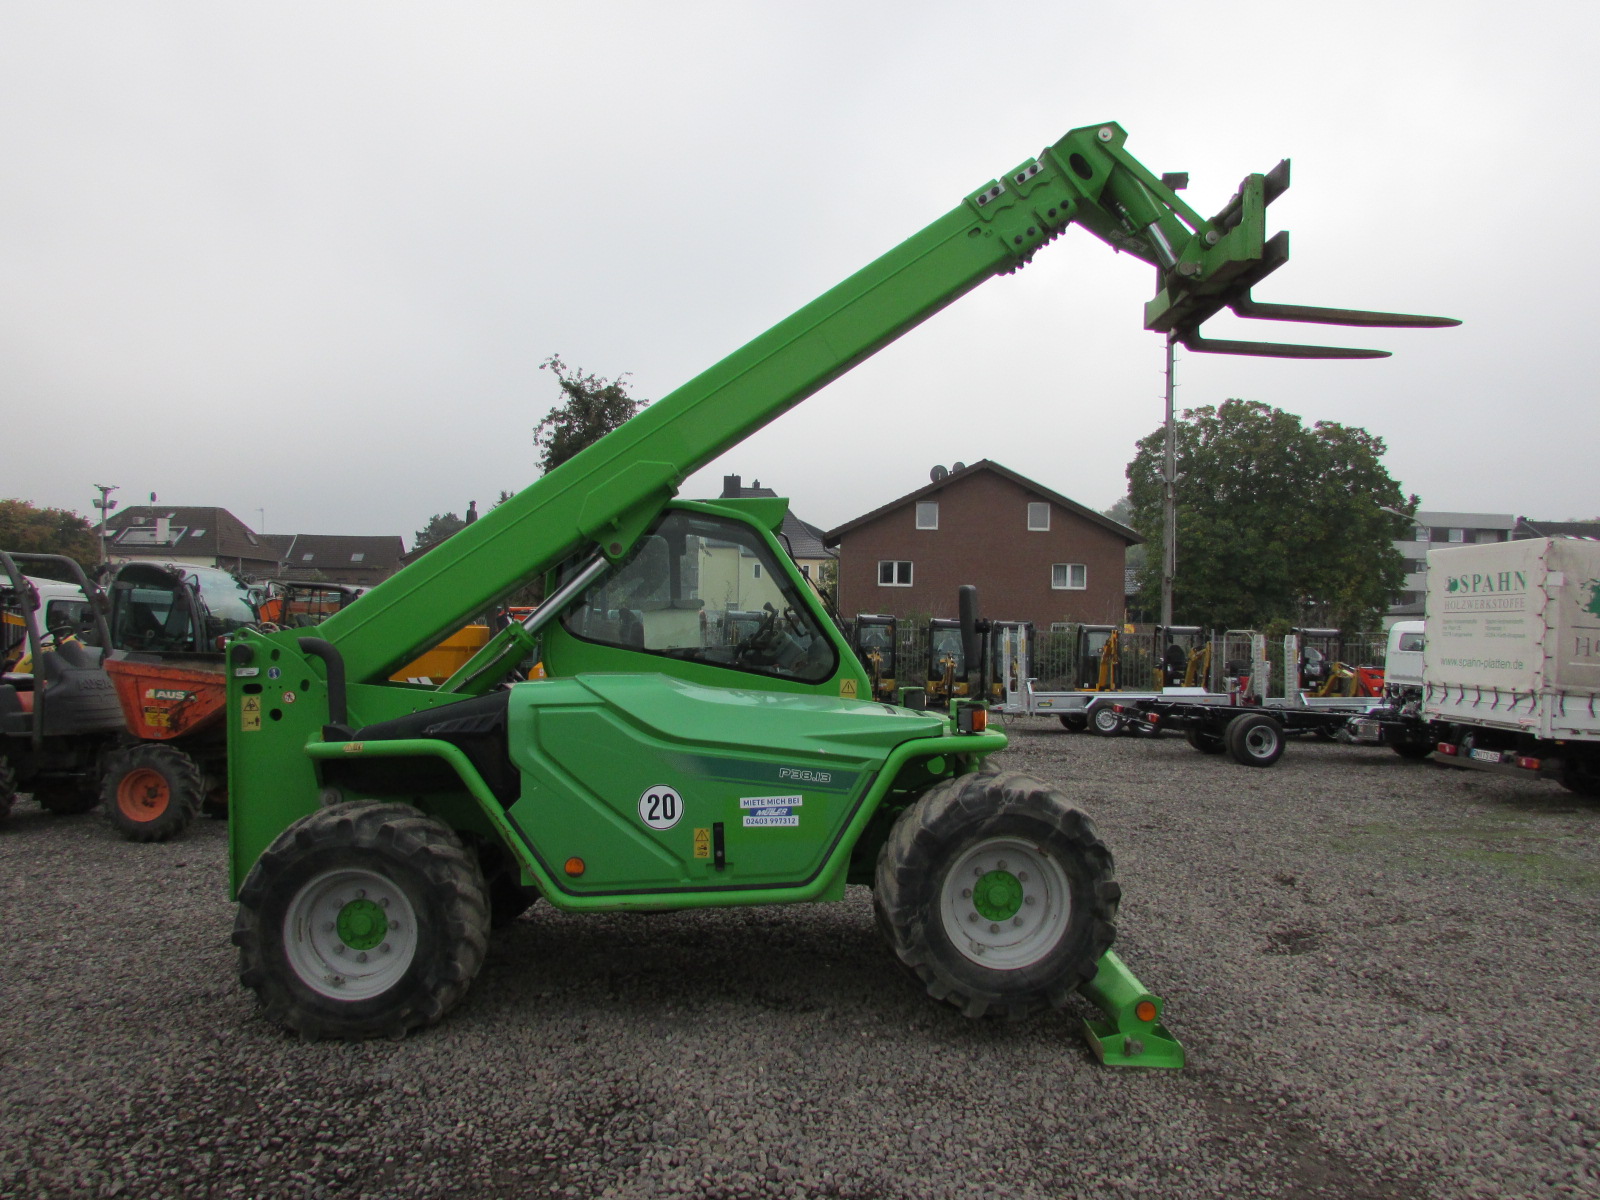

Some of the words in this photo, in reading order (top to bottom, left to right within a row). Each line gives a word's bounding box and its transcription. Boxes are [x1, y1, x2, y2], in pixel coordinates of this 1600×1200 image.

[1460, 570, 1526, 594] SPAHN
[1444, 598, 1525, 610] HOLZWERKSTOFFE
[1575, 636, 1600, 656] H
[1440, 657, 1524, 670] www.spahn-platten.de
[779, 767, 831, 783] P38.13
[647, 793, 676, 821] 20
[743, 799, 765, 807] MIETE
[755, 807, 788, 816] MÜLLER
[745, 817, 768, 825] 02403
[769, 817, 796, 825] 997312
